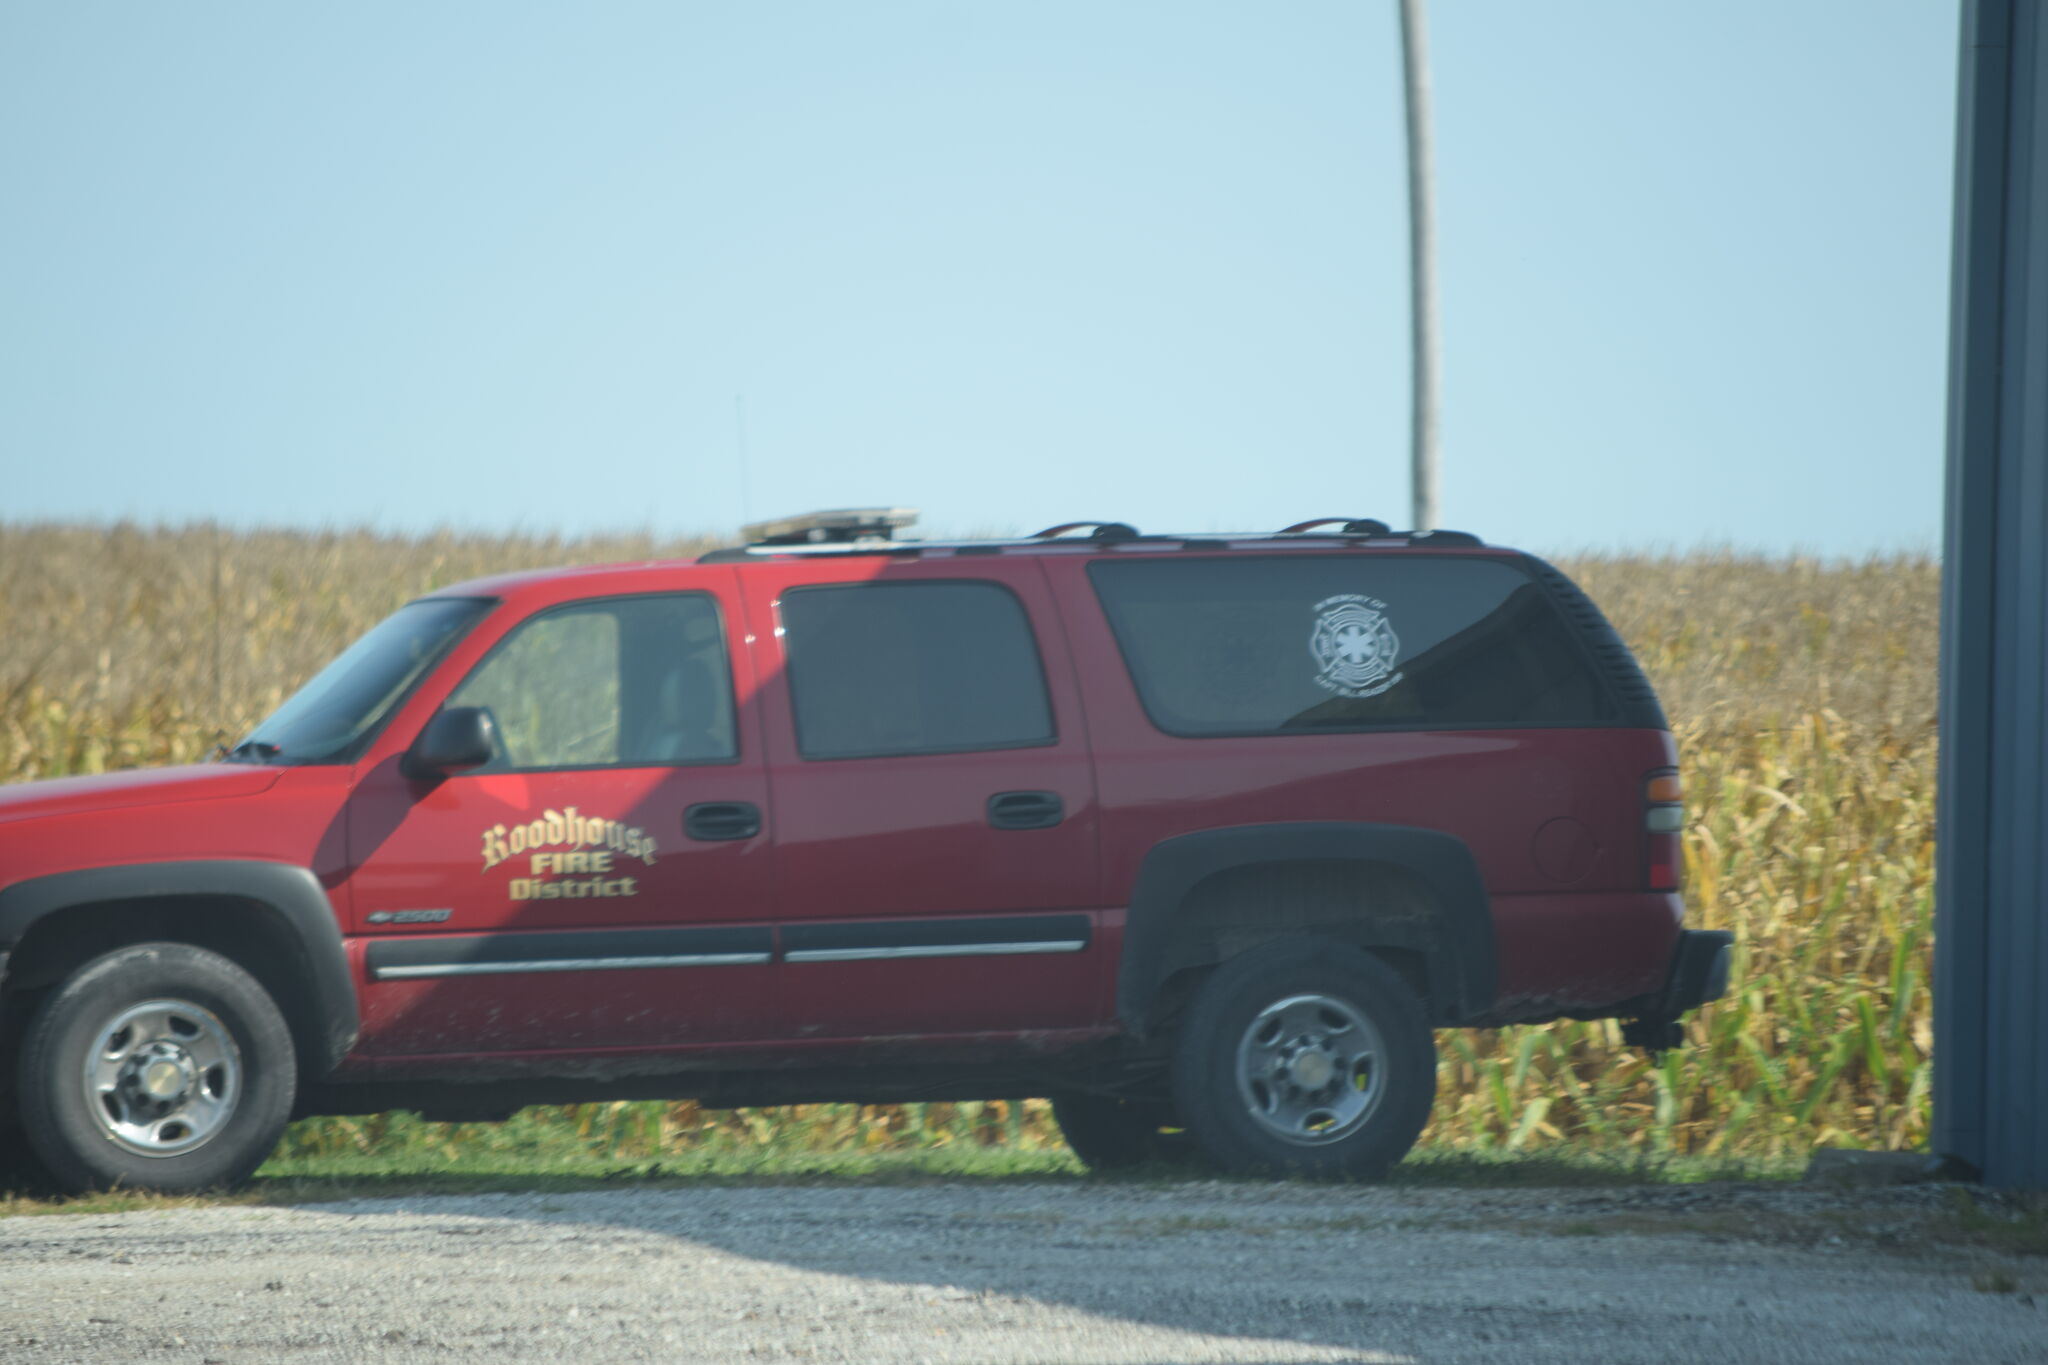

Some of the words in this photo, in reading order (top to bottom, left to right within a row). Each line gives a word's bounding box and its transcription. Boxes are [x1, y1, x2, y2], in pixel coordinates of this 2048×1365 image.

[481, 805, 658, 875] Roodhouse
[530, 851, 614, 875] FIRE
[509, 877, 638, 900] District
